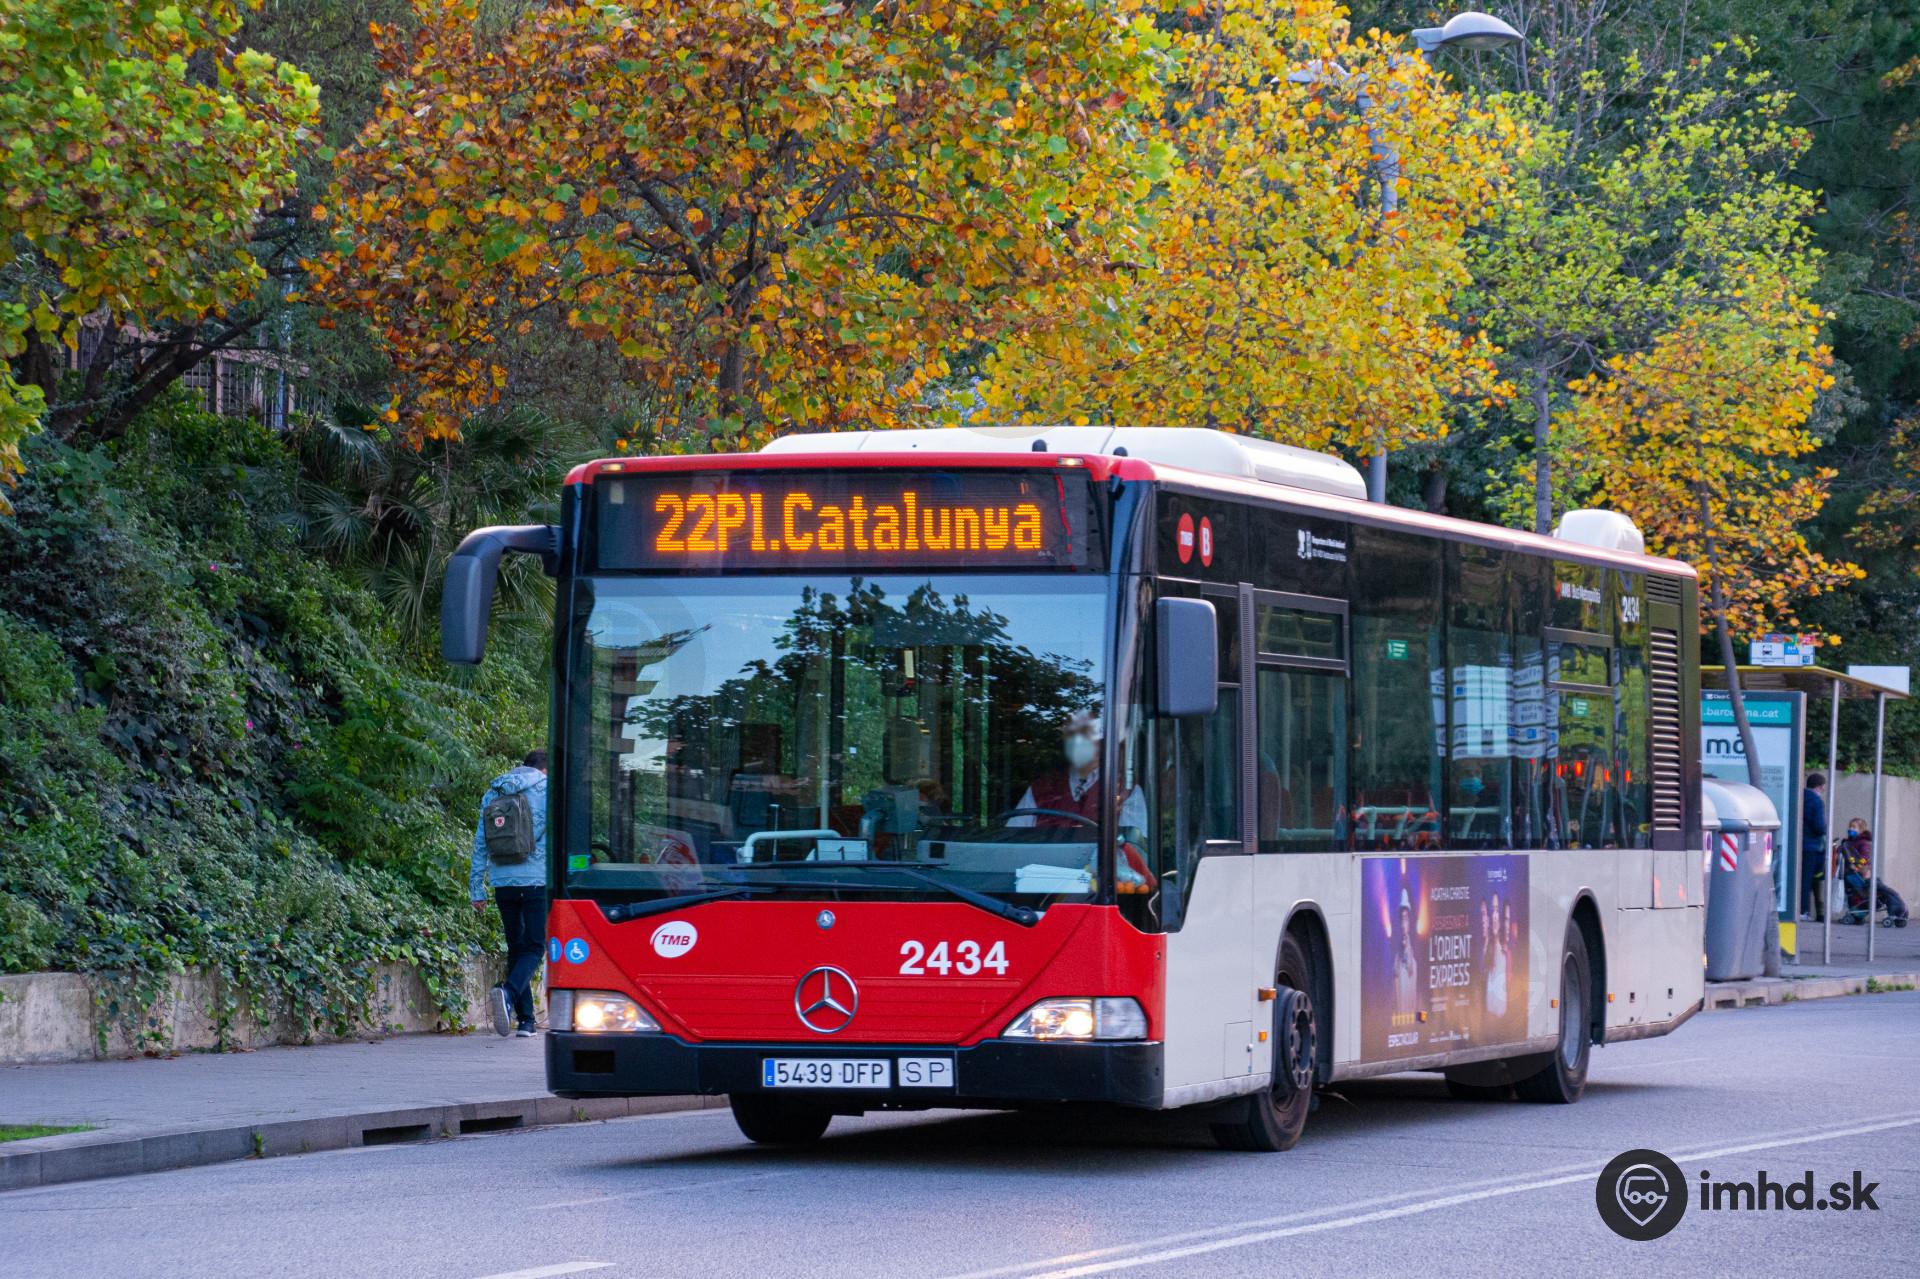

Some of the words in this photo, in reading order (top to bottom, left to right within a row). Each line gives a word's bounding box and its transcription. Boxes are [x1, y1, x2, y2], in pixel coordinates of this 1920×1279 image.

[1622, 595, 1640, 623] 2434
[661, 935, 691, 946] TMB
[1429, 934, 1472, 962] L'ORIENT
[899, 940, 1010, 976] 2434
[1430, 962, 1470, 989] EXPRESS
[777, 1062, 833, 1084] 5439
[842, 1063, 884, 1084] DFP
